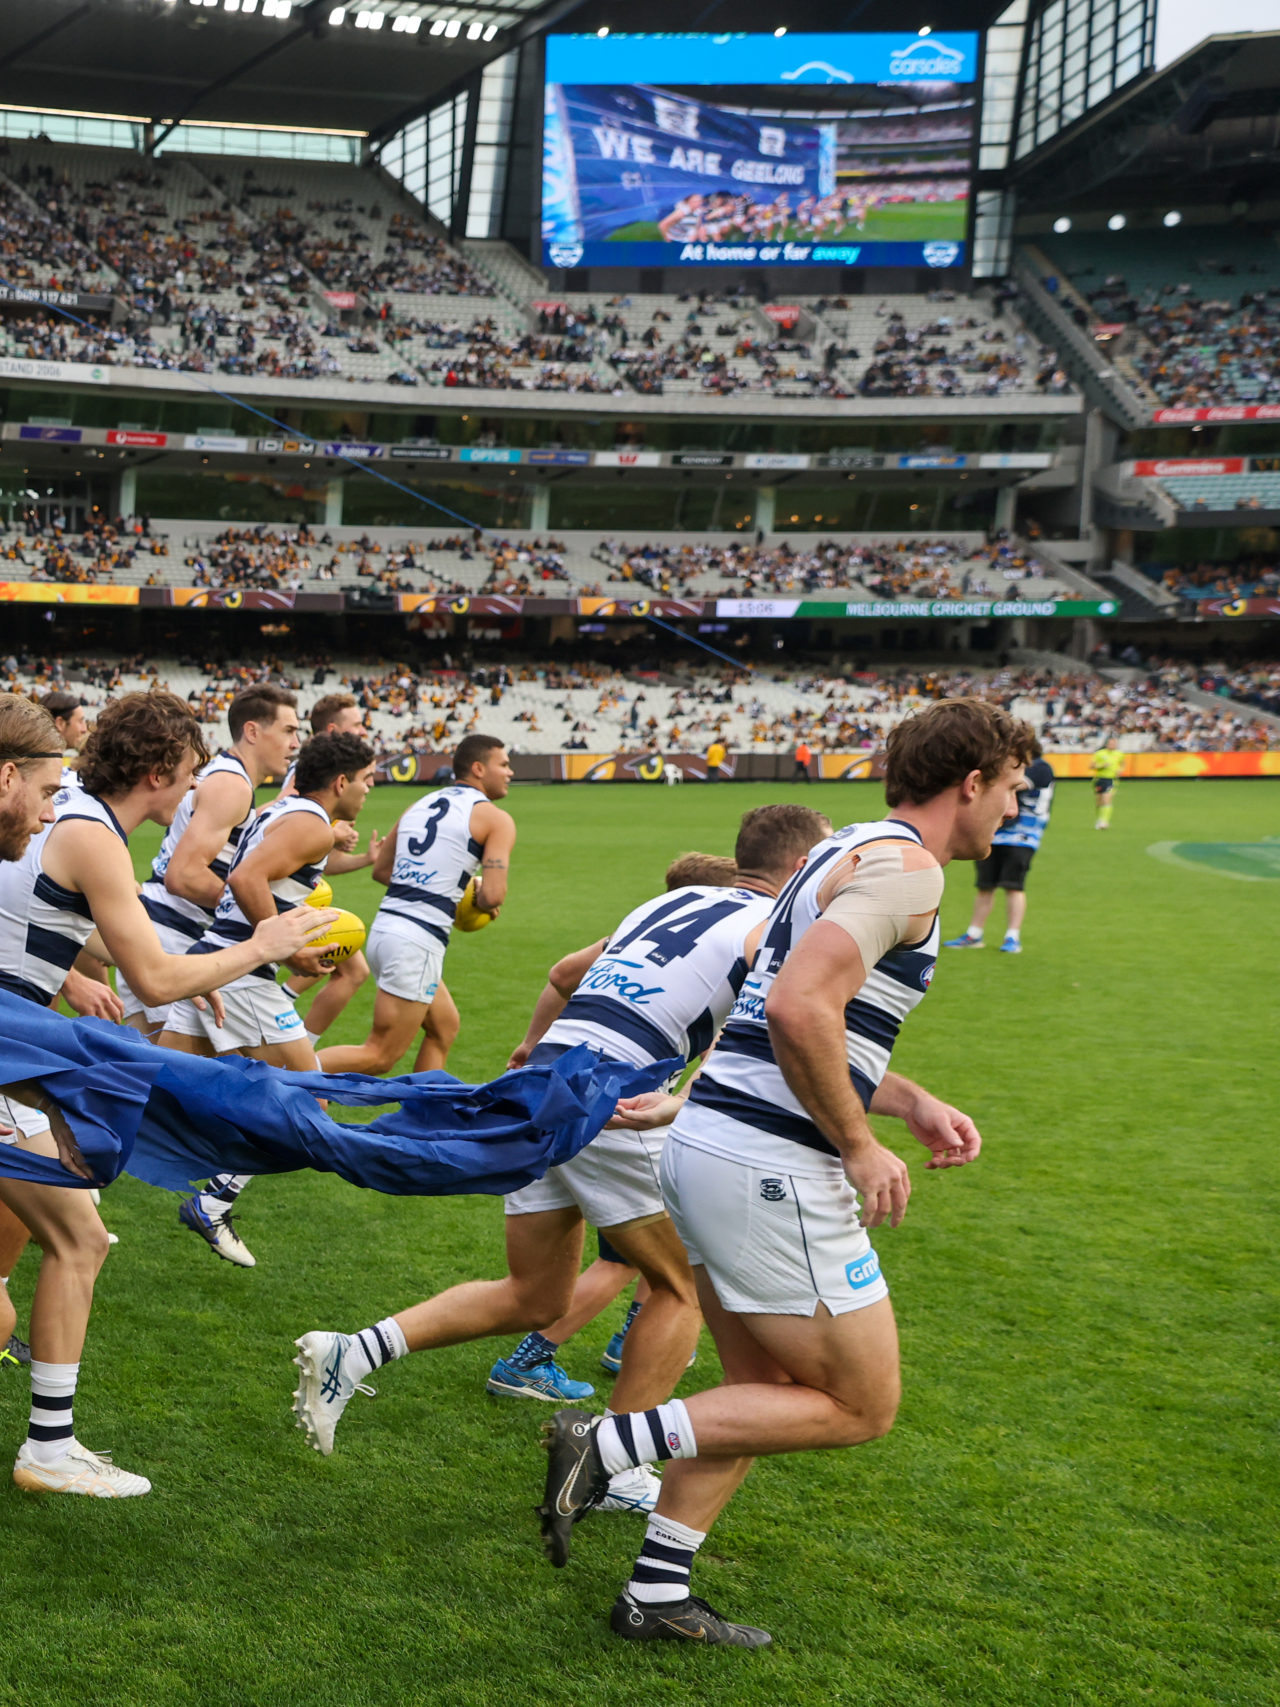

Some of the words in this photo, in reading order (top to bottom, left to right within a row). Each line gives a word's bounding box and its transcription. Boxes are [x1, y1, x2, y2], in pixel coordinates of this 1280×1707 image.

[889, 57, 962, 75] carsales
[592, 127, 656, 163] WE
[669, 146, 722, 175] ARE
[731, 159, 805, 185] GEELONG
[680, 244, 704, 260] At
[706, 243, 758, 260] home
[759, 247, 782, 260] or
[783, 242, 812, 260] far
[812, 246, 861, 265] away
[471, 449, 510, 462] OPTUS
[846, 602, 929, 617] MELBOURNE
[932, 602, 991, 617] CRICKET
[993, 602, 1057, 617] GROUND
[408, 797, 450, 857] 3
[391, 857, 438, 885] Ford
[607, 891, 747, 968] 14
[577, 958, 666, 1004] Ford
